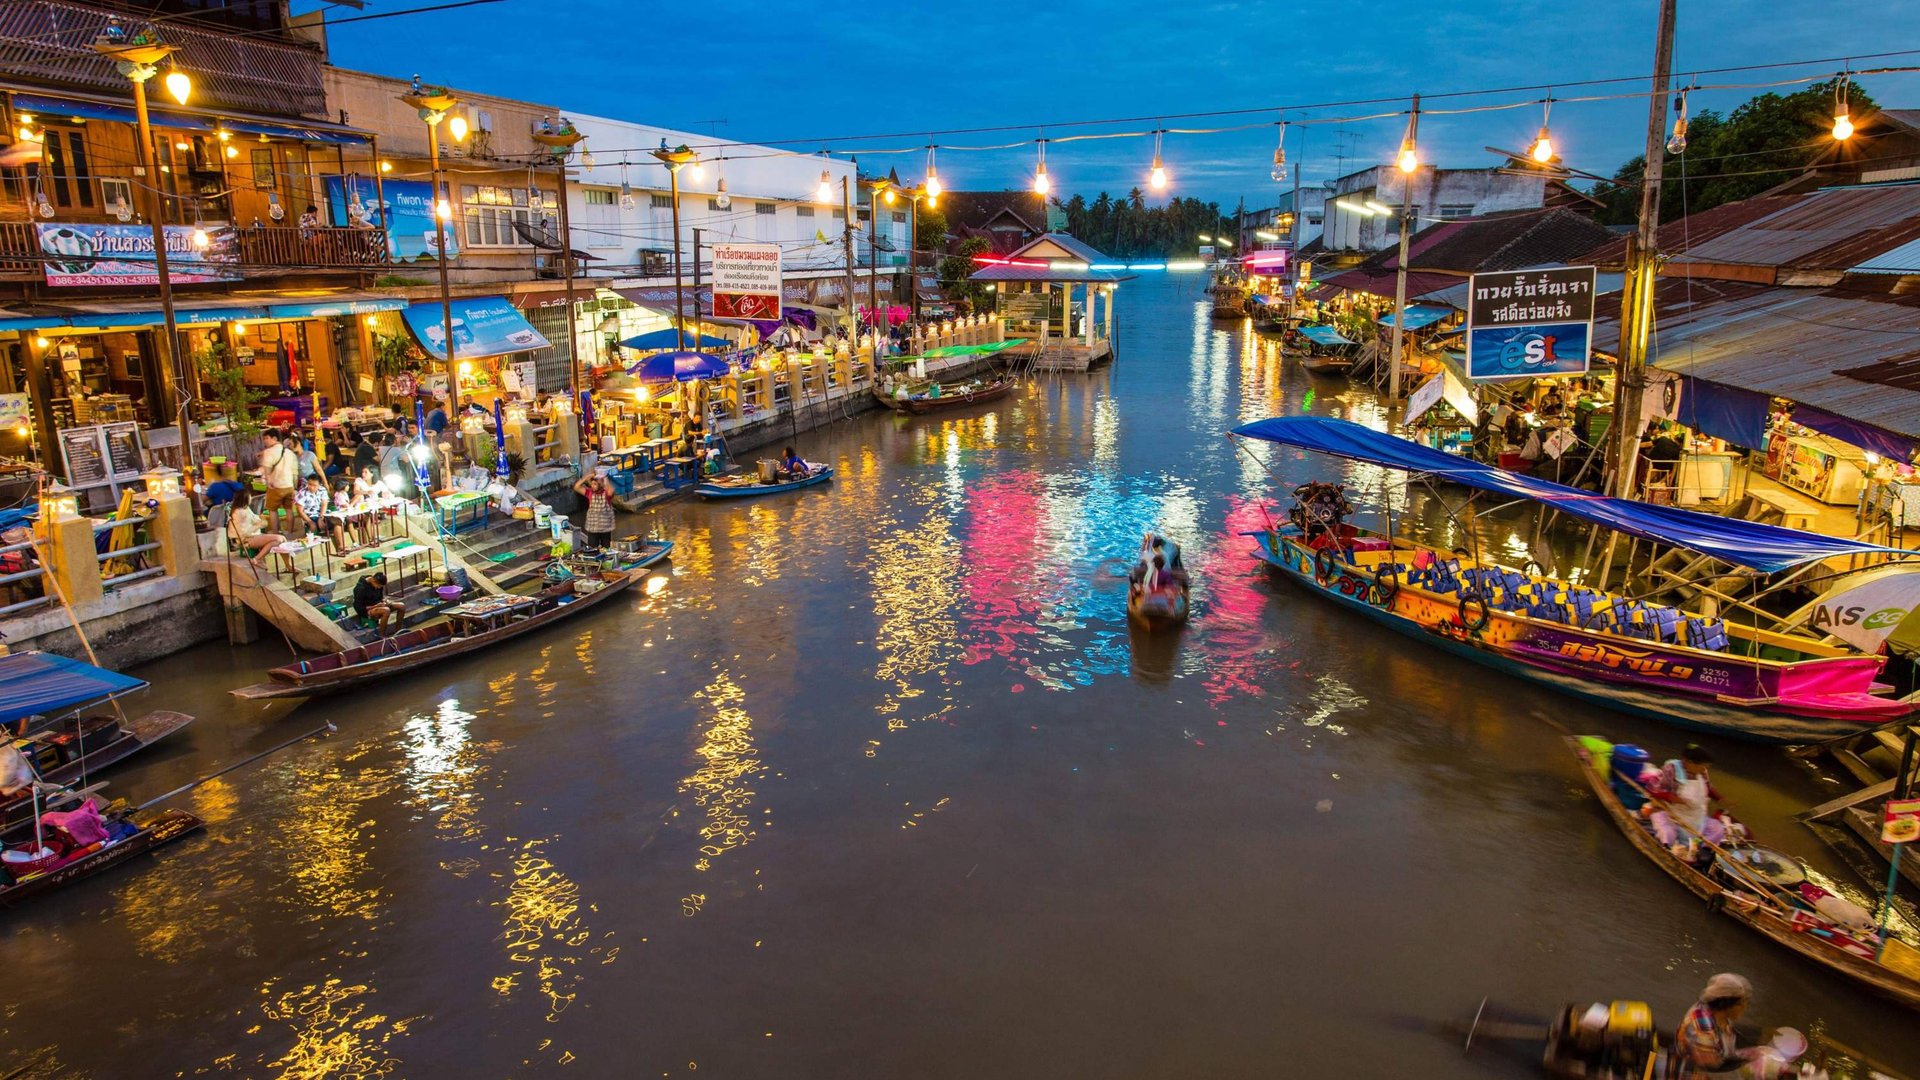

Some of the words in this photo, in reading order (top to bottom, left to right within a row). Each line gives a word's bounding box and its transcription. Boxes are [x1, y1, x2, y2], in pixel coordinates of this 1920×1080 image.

[1500, 336, 1556, 369] est
[1814, 604, 1866, 627] AIS
[1869, 611, 1904, 624] 3G
[1699, 674, 1730, 687] 80171
